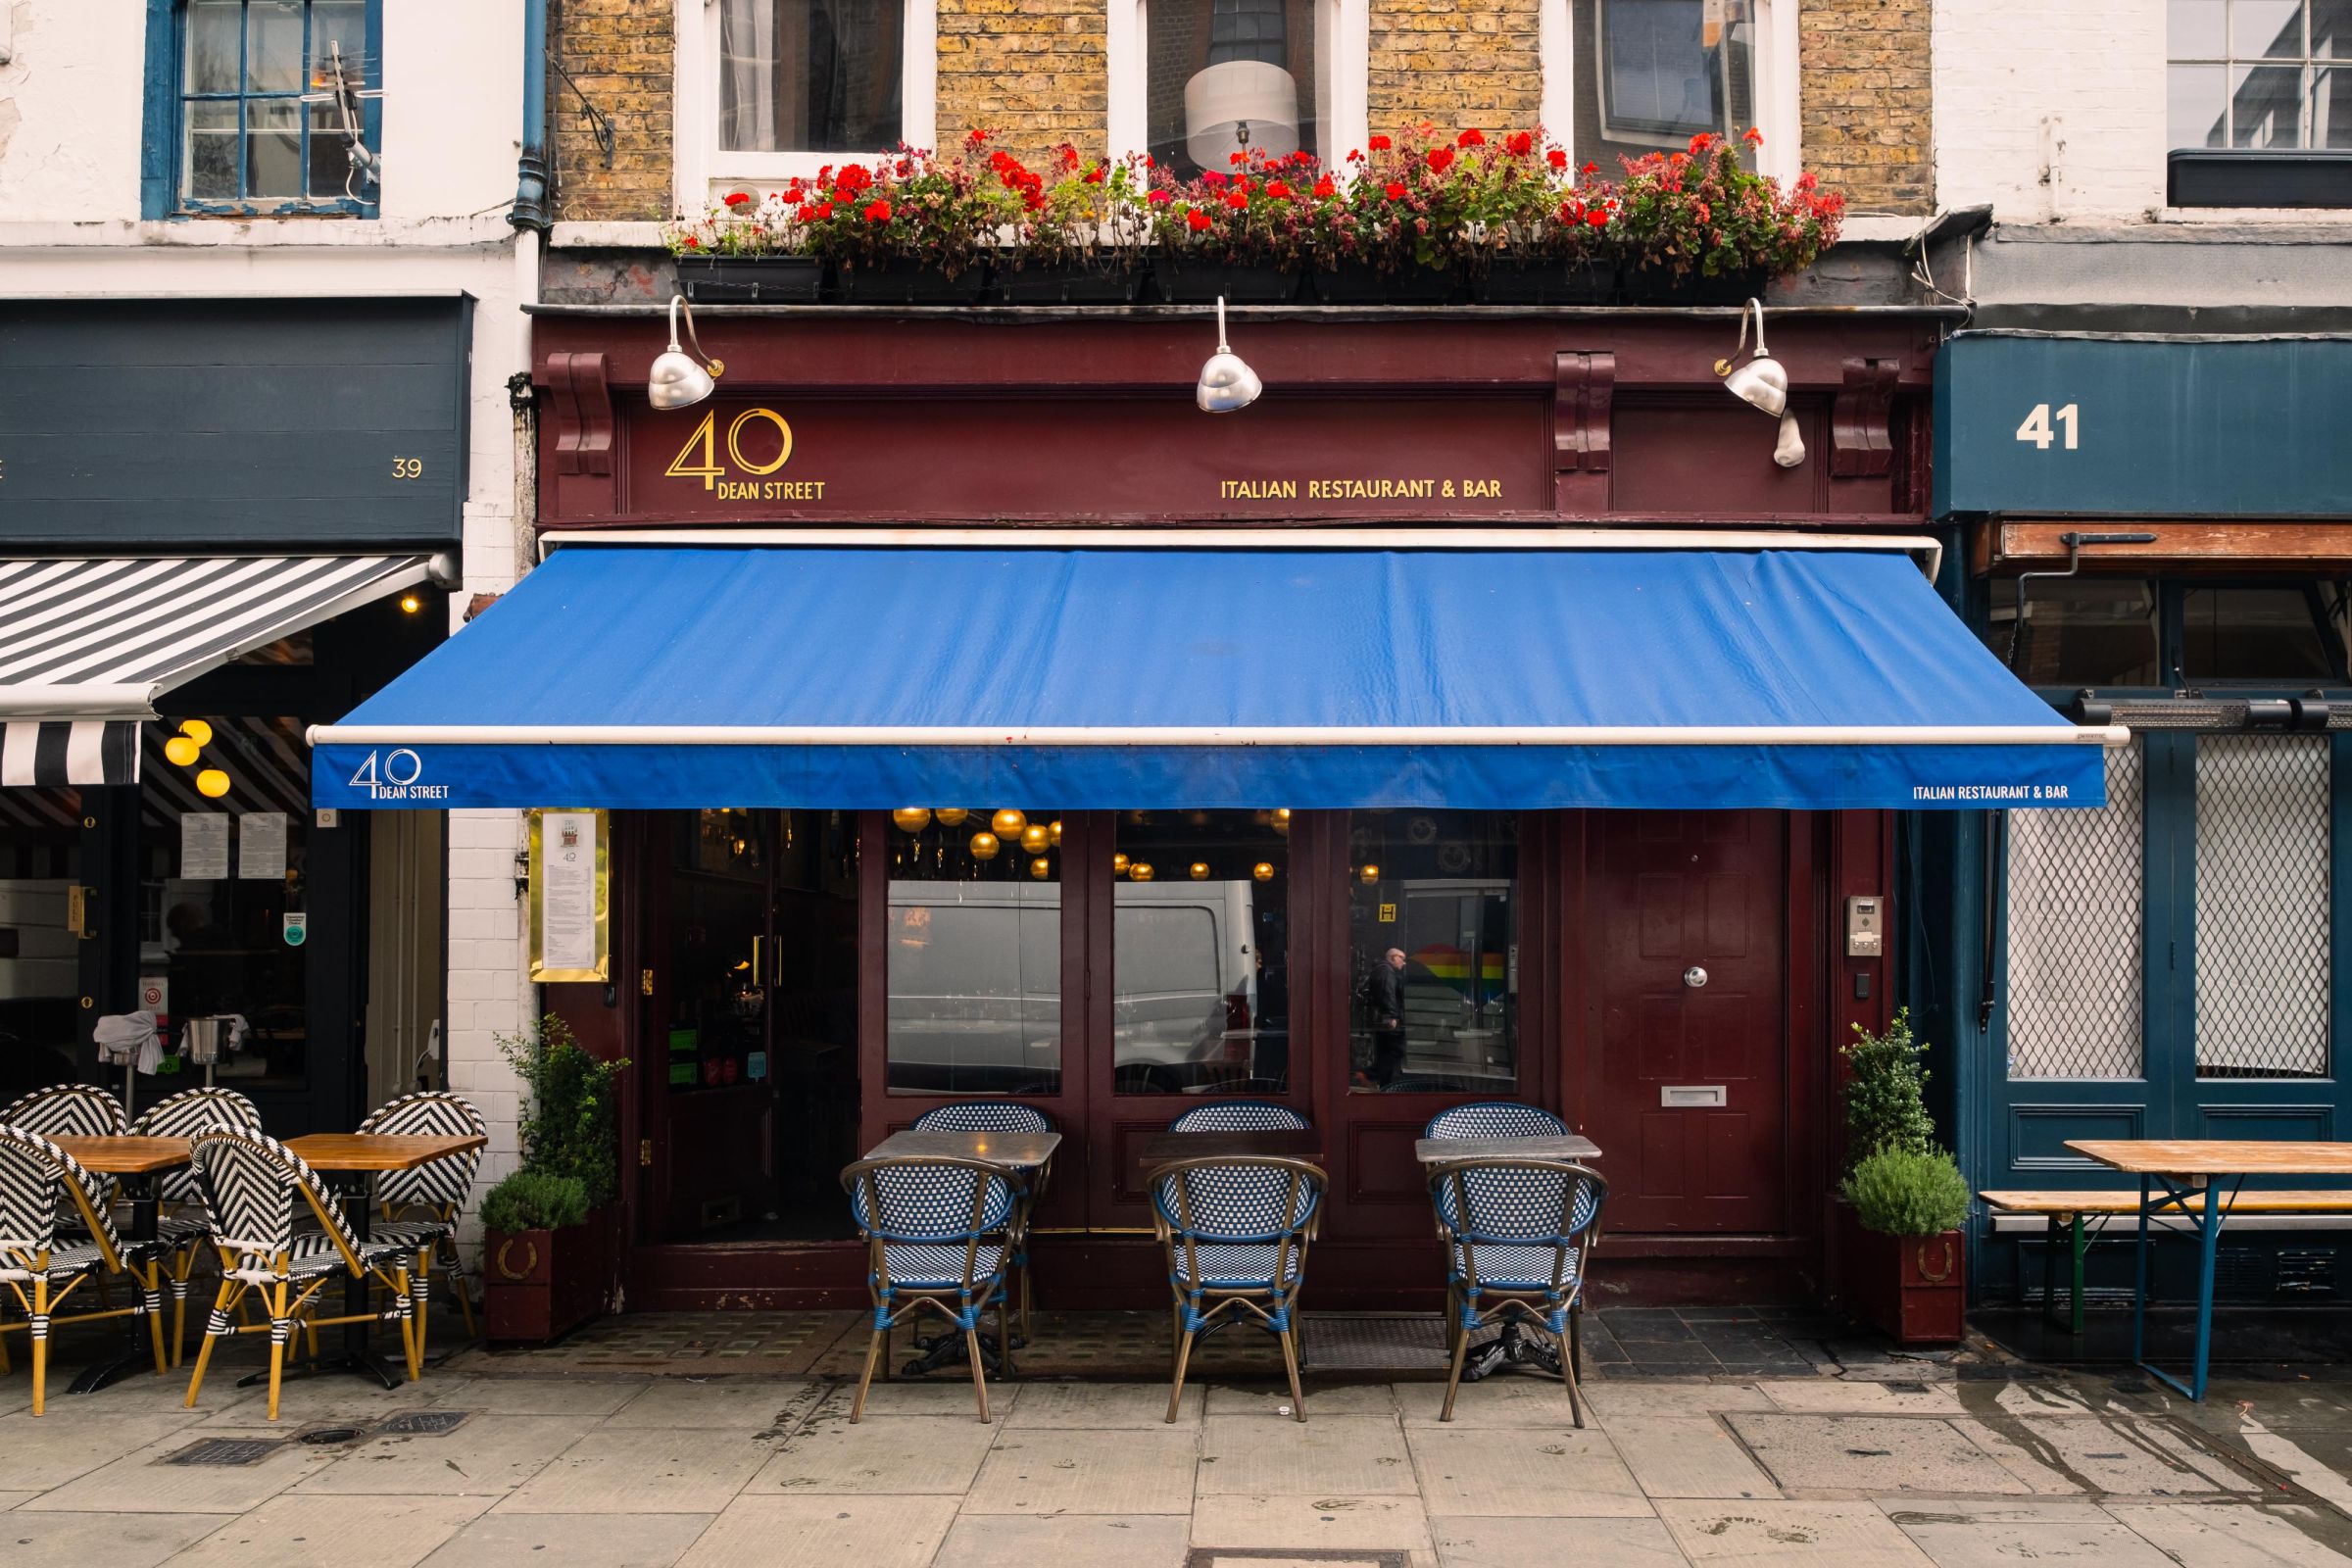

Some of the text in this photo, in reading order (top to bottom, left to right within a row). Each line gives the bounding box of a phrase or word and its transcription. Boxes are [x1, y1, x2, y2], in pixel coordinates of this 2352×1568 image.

[2016, 403, 2079, 449] 41
[664, 408, 793, 491] 40
[392, 458, 422, 478] 39
[717, 481, 825, 500] DEAN STREET
[1221, 479, 1502, 499] ITALIAN RESTAURANT & BAR
[348, 748, 422, 800] 40
[379, 785, 449, 800] DEAN STREET
[1913, 785, 2069, 800] ITALIAN RESTAURANT & BAR
